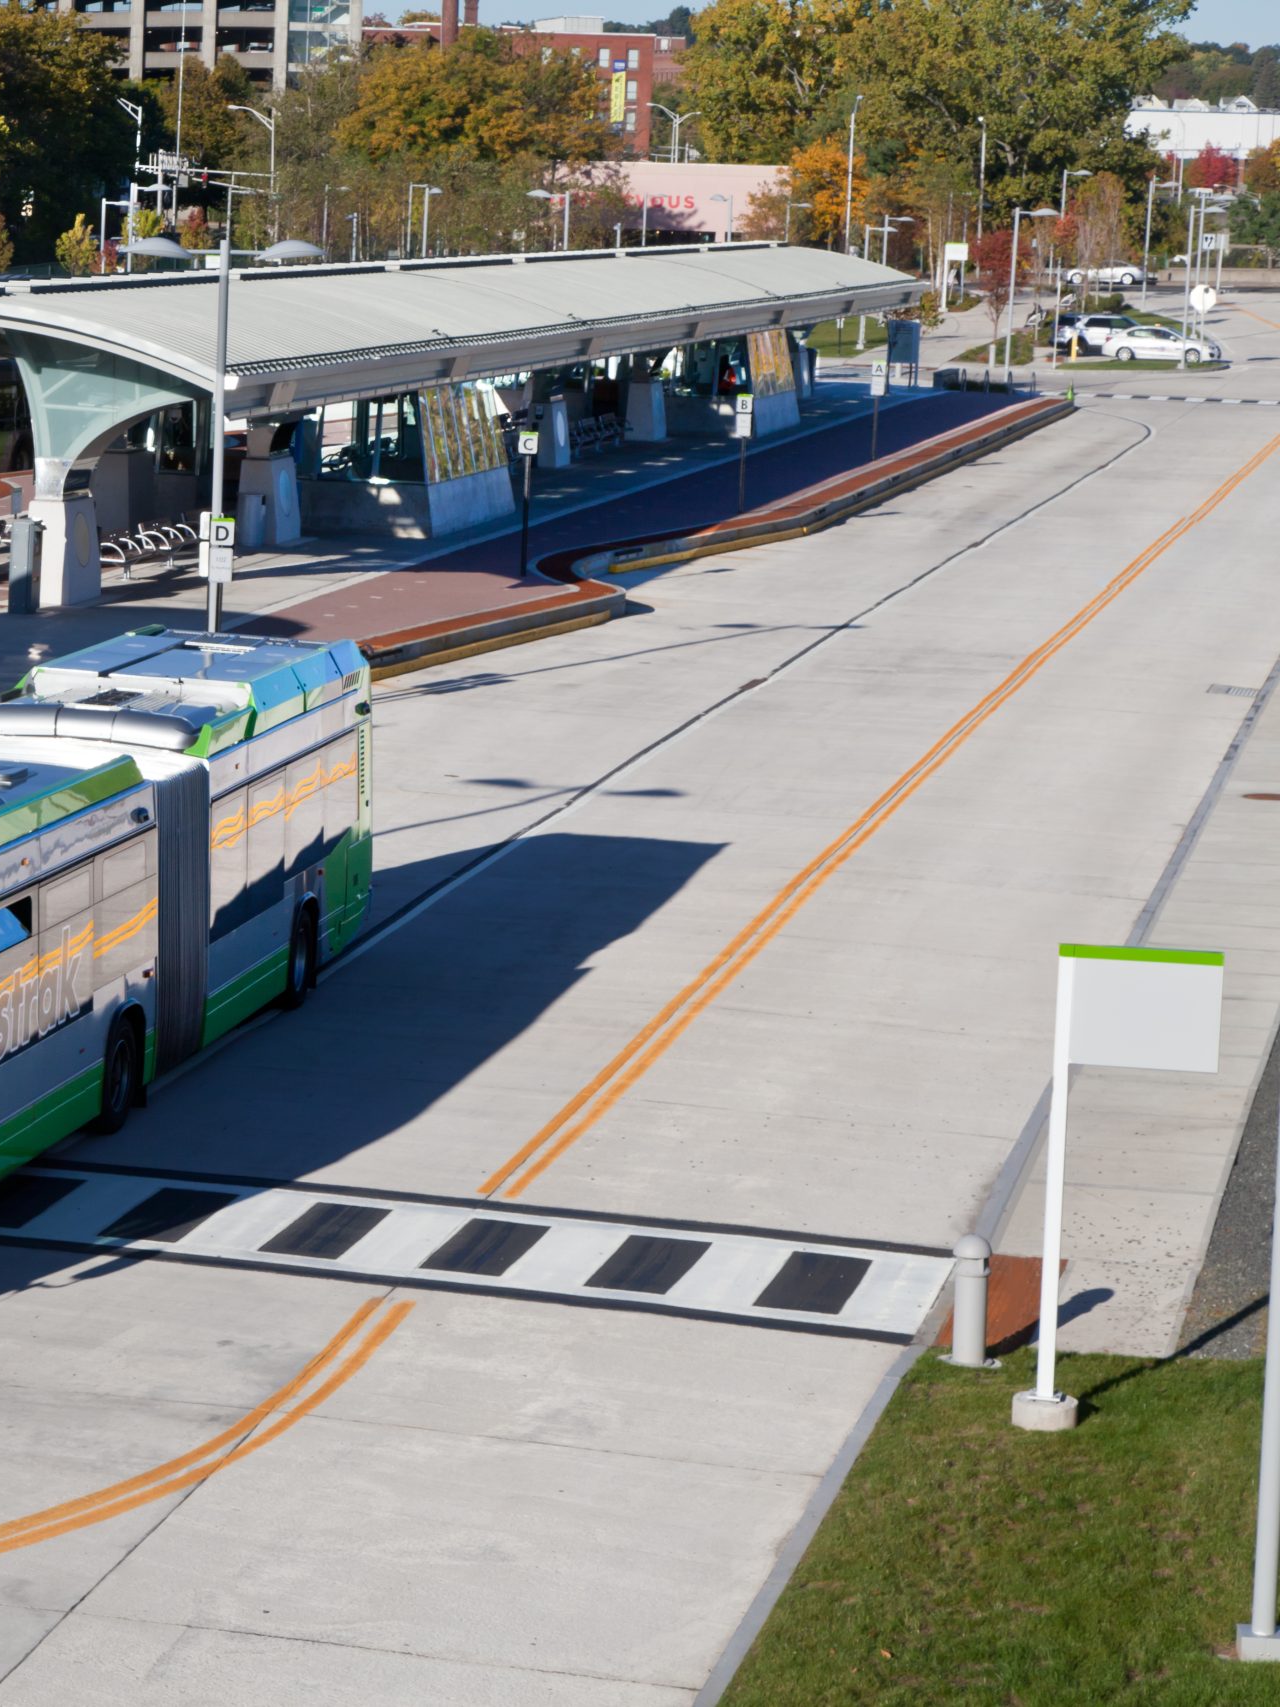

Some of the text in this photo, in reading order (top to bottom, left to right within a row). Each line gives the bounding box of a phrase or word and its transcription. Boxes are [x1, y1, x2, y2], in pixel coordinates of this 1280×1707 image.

[874, 364, 884, 373] A
[741, 399, 748, 410] B
[523, 438, 534, 451] C
[215, 525, 230, 541] D
